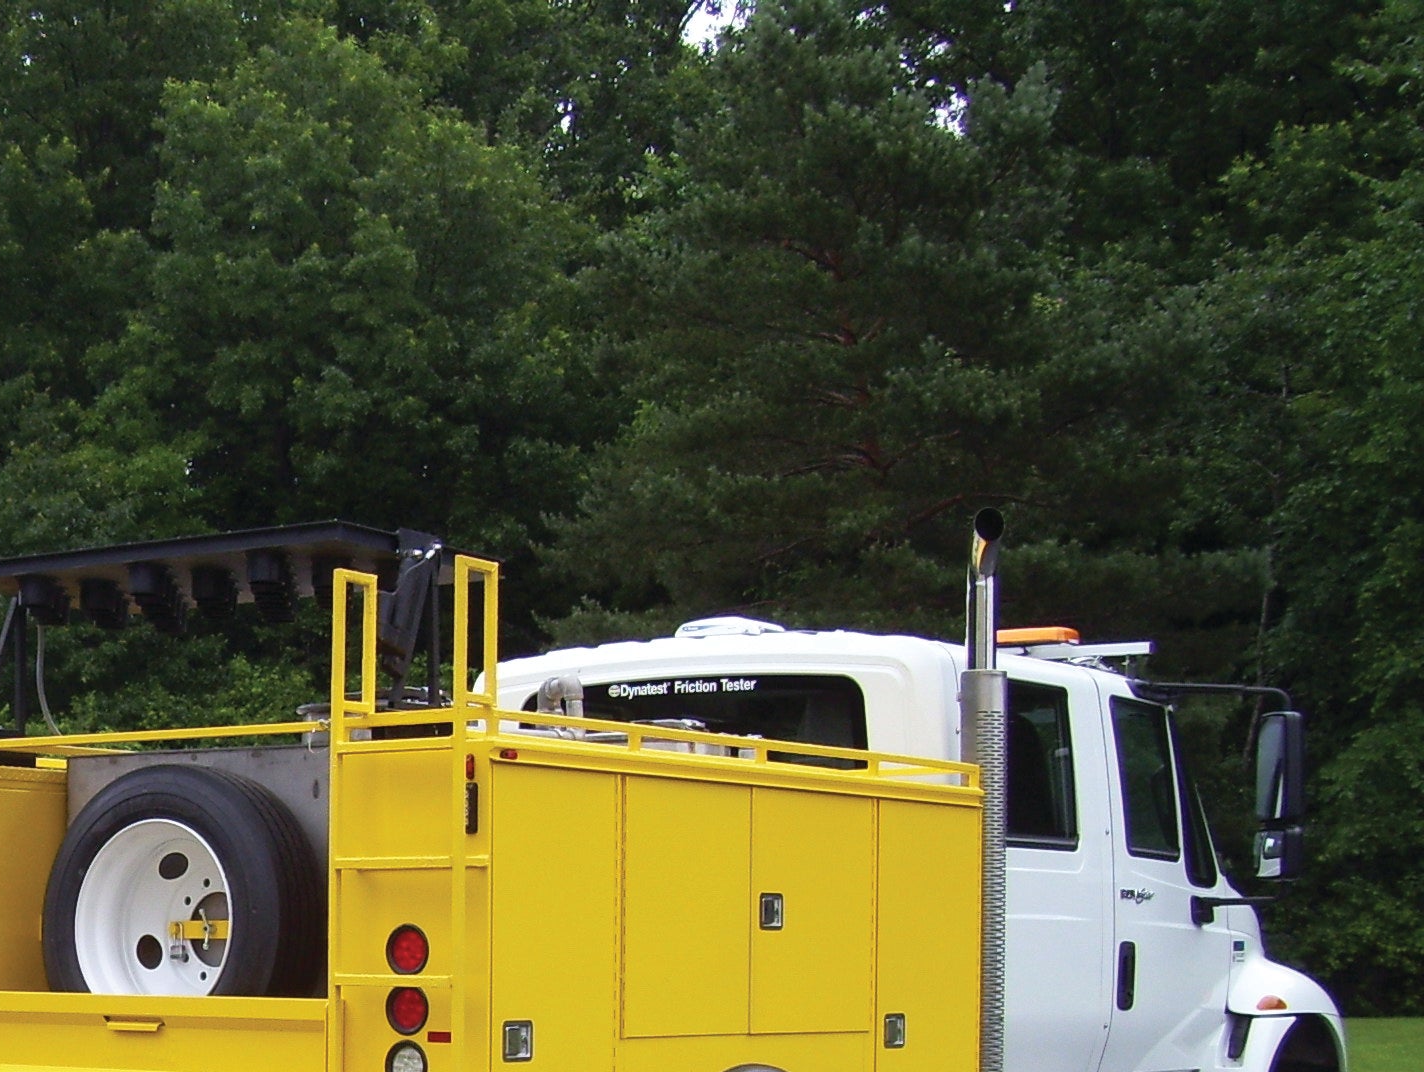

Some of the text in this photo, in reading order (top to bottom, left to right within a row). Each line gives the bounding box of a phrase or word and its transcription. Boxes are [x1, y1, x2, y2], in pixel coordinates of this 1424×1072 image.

[620, 679, 757, 699] Dynatest Friction Tester
